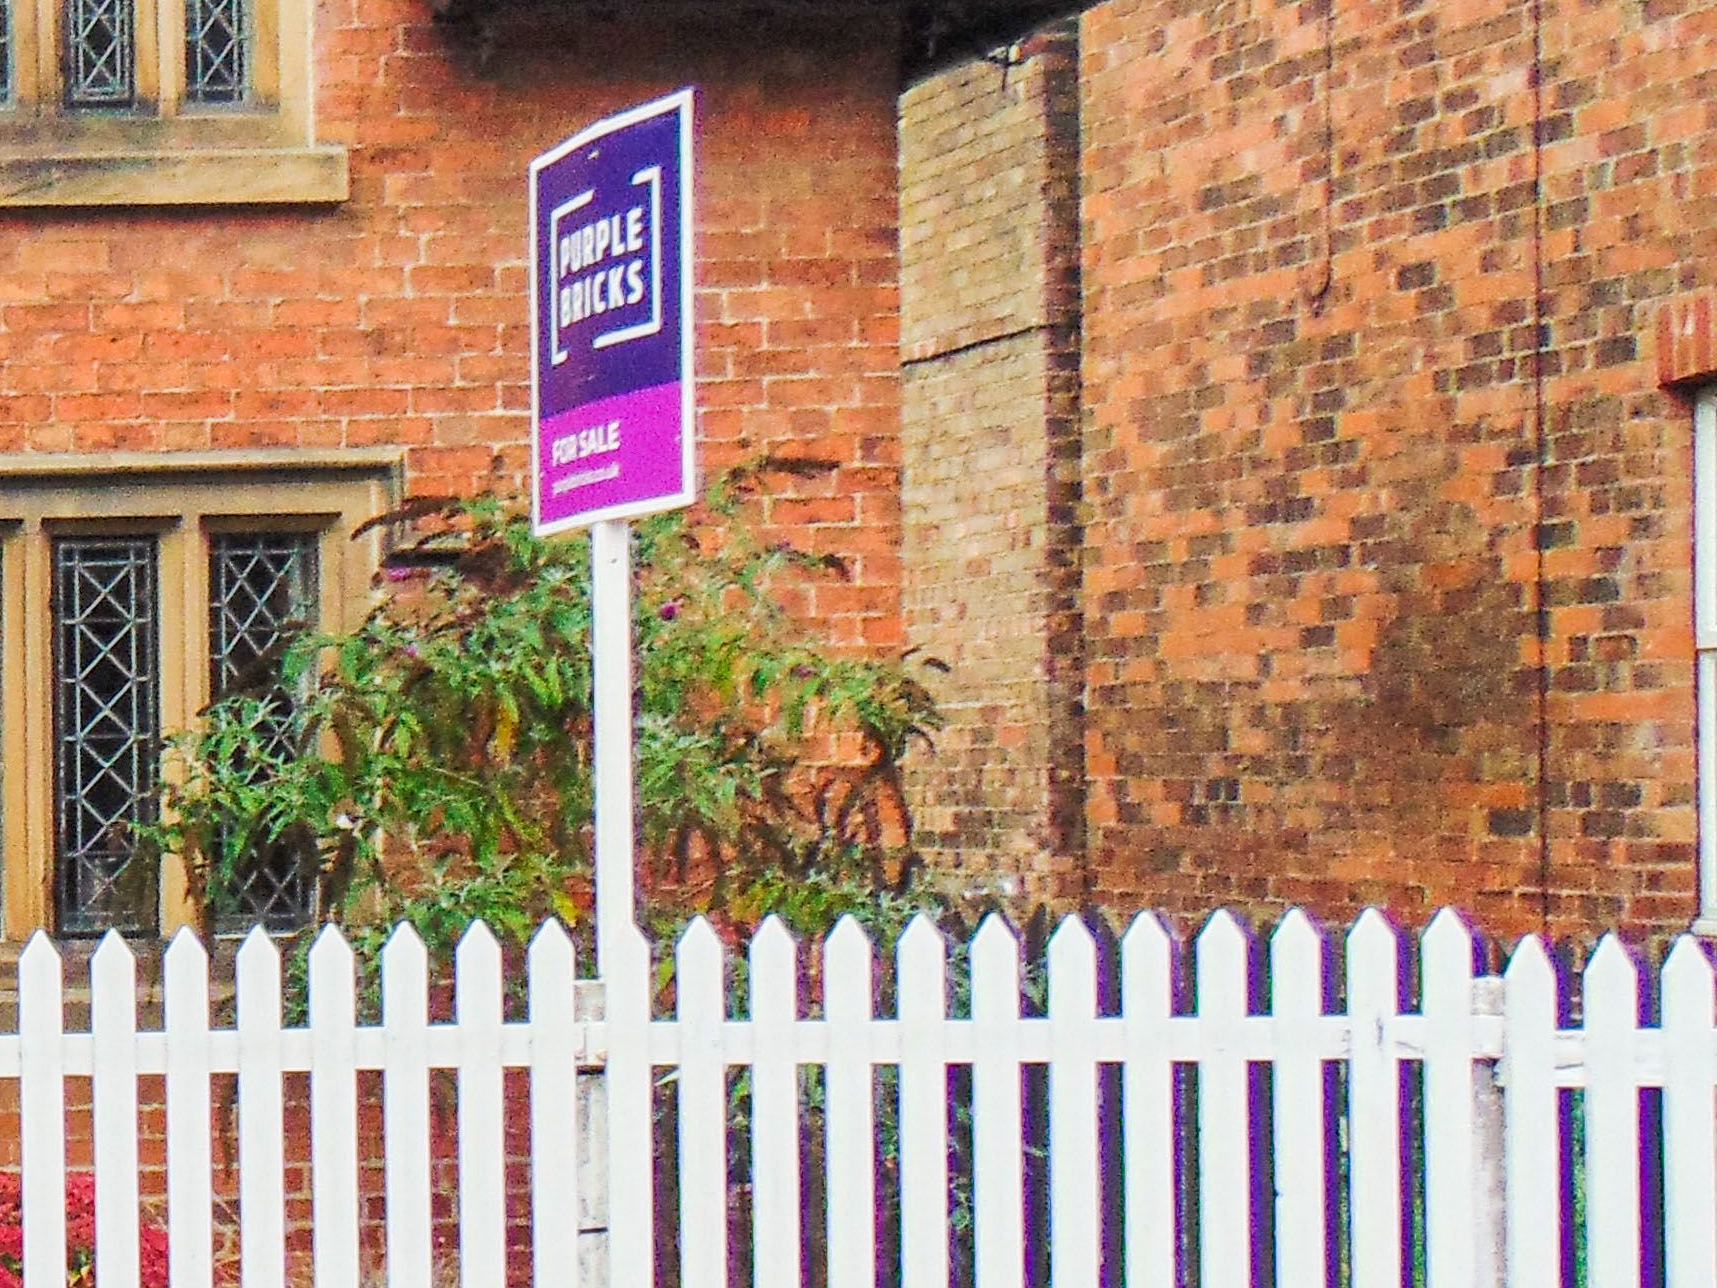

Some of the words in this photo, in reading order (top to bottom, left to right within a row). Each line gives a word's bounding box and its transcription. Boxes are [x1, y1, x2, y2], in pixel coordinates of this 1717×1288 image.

[560, 207, 643, 279] PURPLE
[560, 259, 643, 328] BRICKS
[552, 434, 578, 466] FOR
[578, 421, 620, 458] SALE
